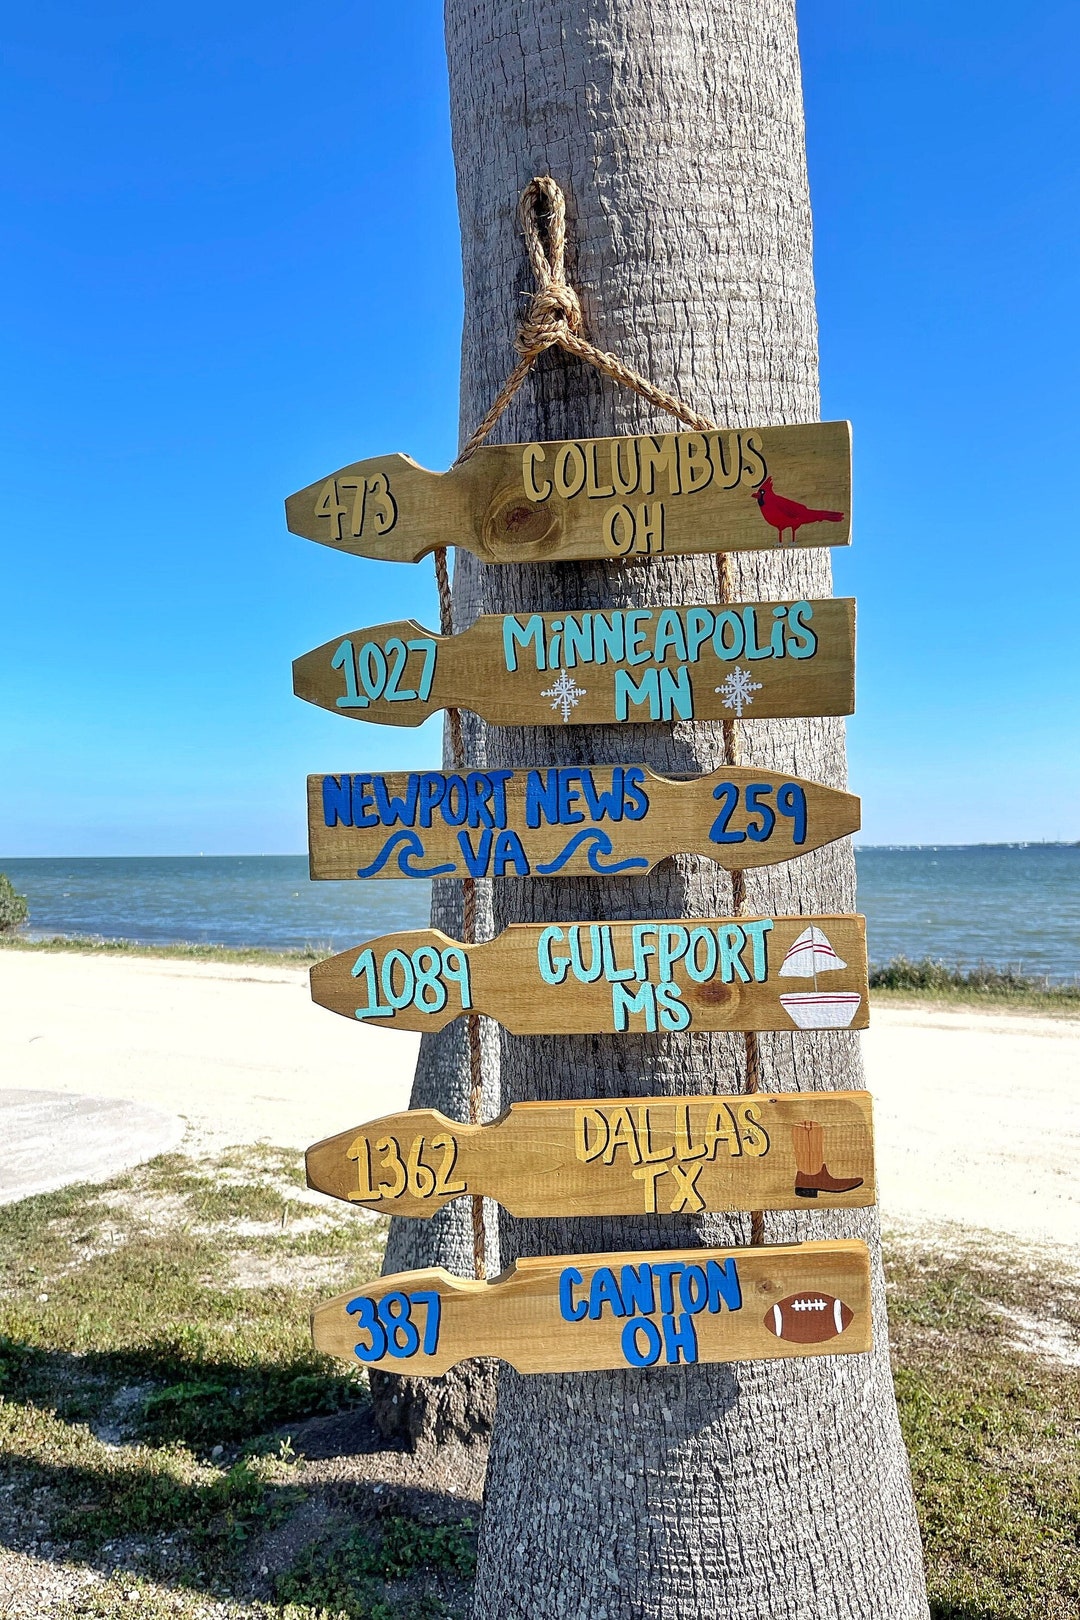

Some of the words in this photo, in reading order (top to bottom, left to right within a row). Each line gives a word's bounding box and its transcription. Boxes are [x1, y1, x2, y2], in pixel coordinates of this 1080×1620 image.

[522, 431, 766, 502] COLUMBUS
[314, 472, 398, 540] 473
[602, 501, 665, 556] OH
[331, 638, 437, 708] 1027
[614, 666, 693, 721] MN
[321, 769, 513, 828] NEWPORT
[525, 766, 649, 828] NEWS
[709, 782, 807, 845] 259
[457, 829, 530, 878] VA
[538, 918, 774, 984] GULFPORT
[351, 946, 472, 1020] 1089
[612, 981, 692, 1032] MS
[575, 1102, 770, 1165] DALLAS
[346, 1134, 467, 1202] 1362
[633, 1163, 707, 1214] TX
[559, 1258, 742, 1322] CANTON
[346, 1291, 441, 1362] 387
[621, 1314, 698, 1366] OH
